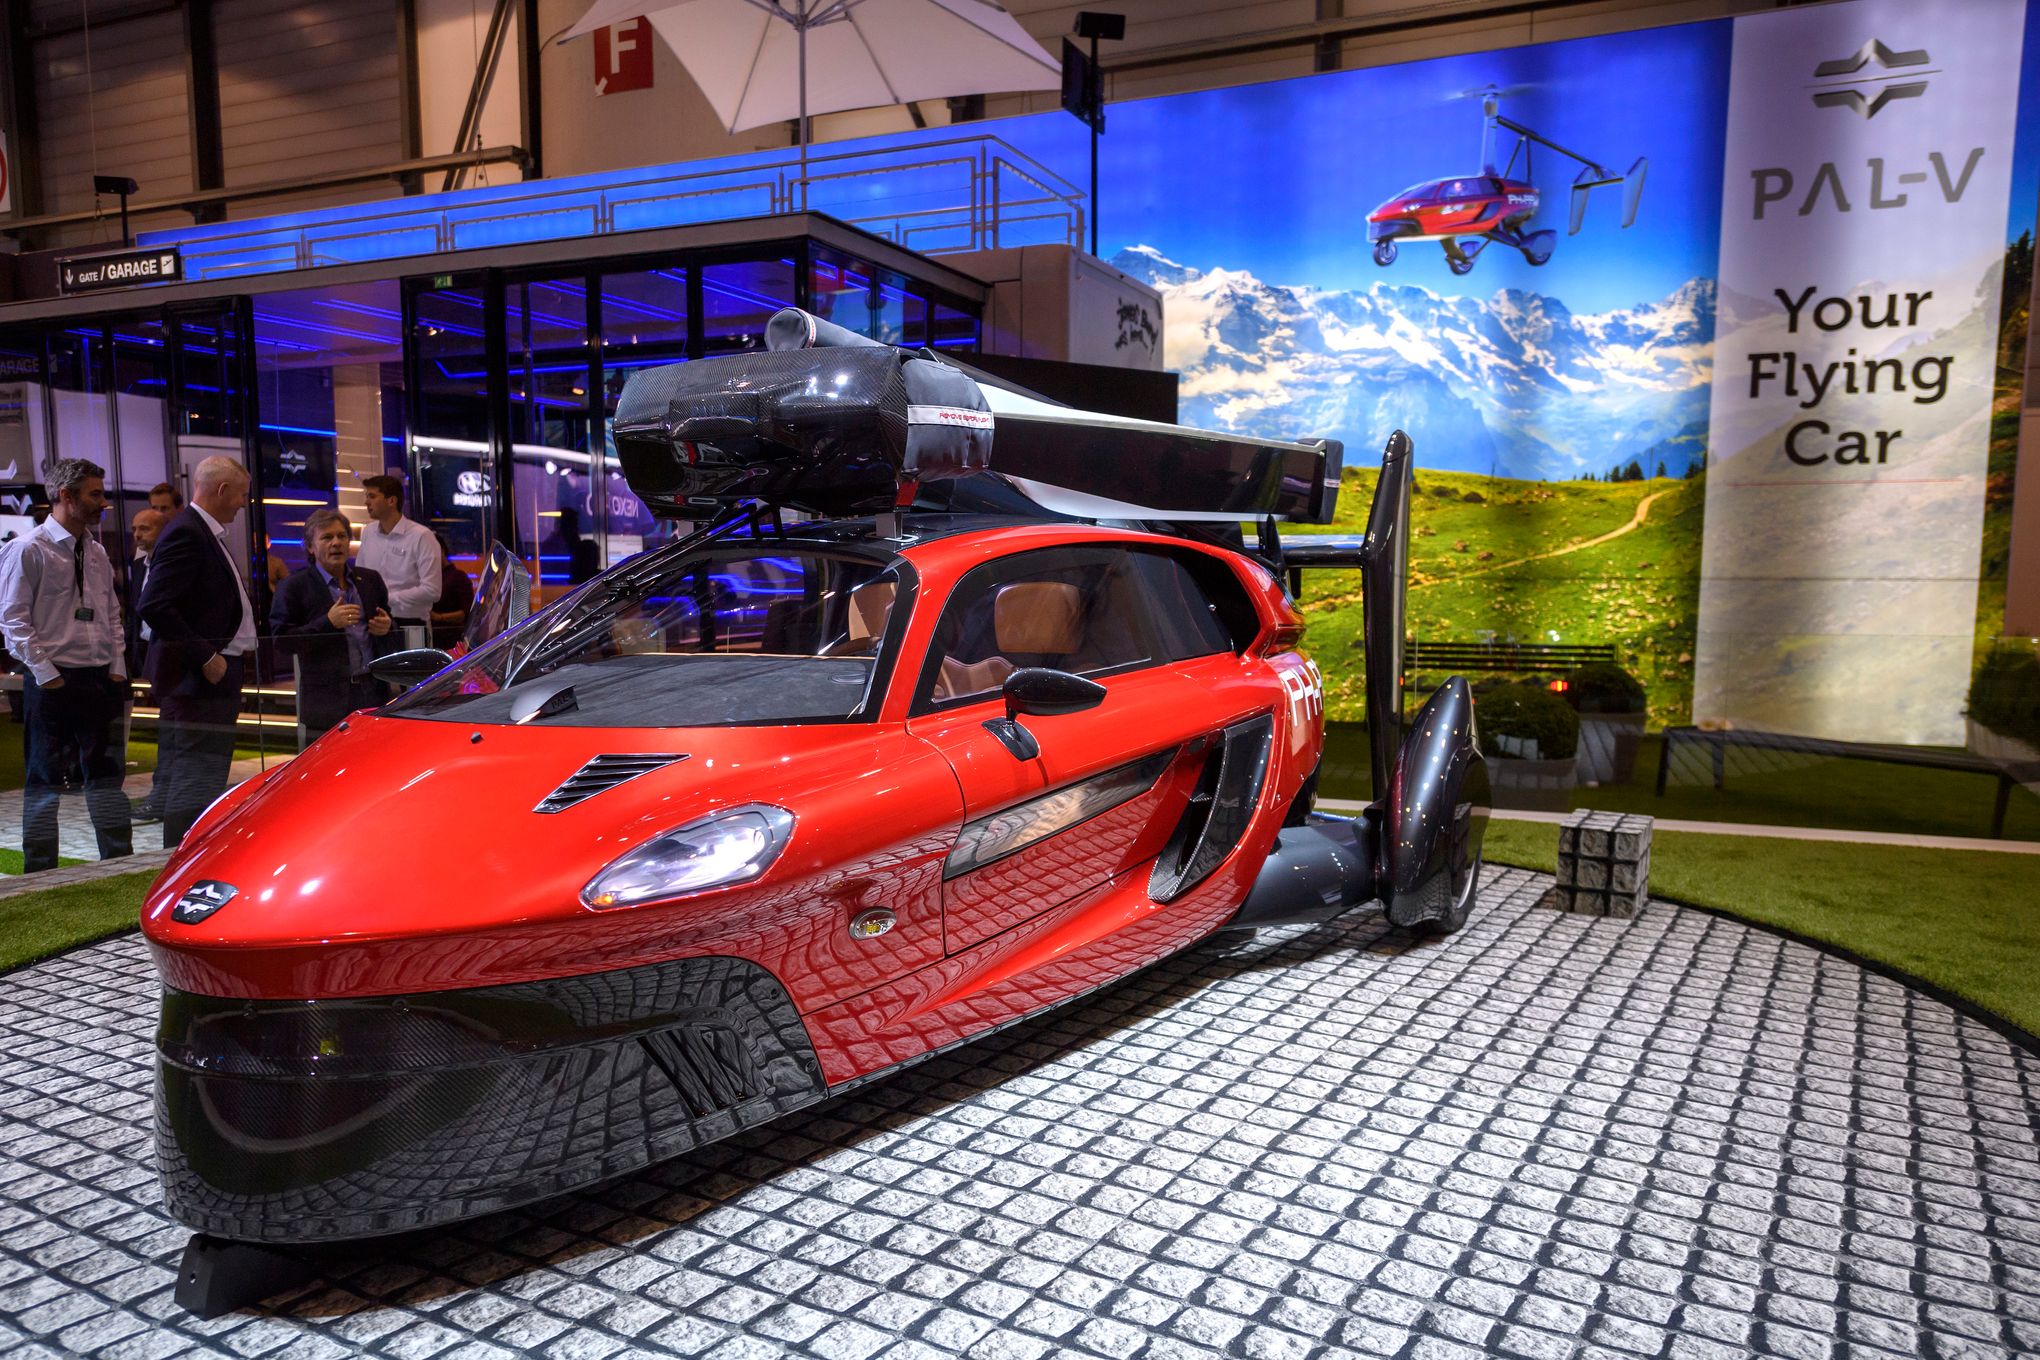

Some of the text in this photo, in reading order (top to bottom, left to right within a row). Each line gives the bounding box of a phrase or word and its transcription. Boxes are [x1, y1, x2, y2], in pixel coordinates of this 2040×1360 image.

[610, 19, 639, 75] F
[1751, 147, 1985, 220] PAL-V
[79, 271, 99, 283] GATE
[107, 259, 158, 280] GARAGE
[1774, 286, 1932, 333] Your
[1748, 348, 1954, 409] Flying
[1784, 420, 1902, 466] Car
